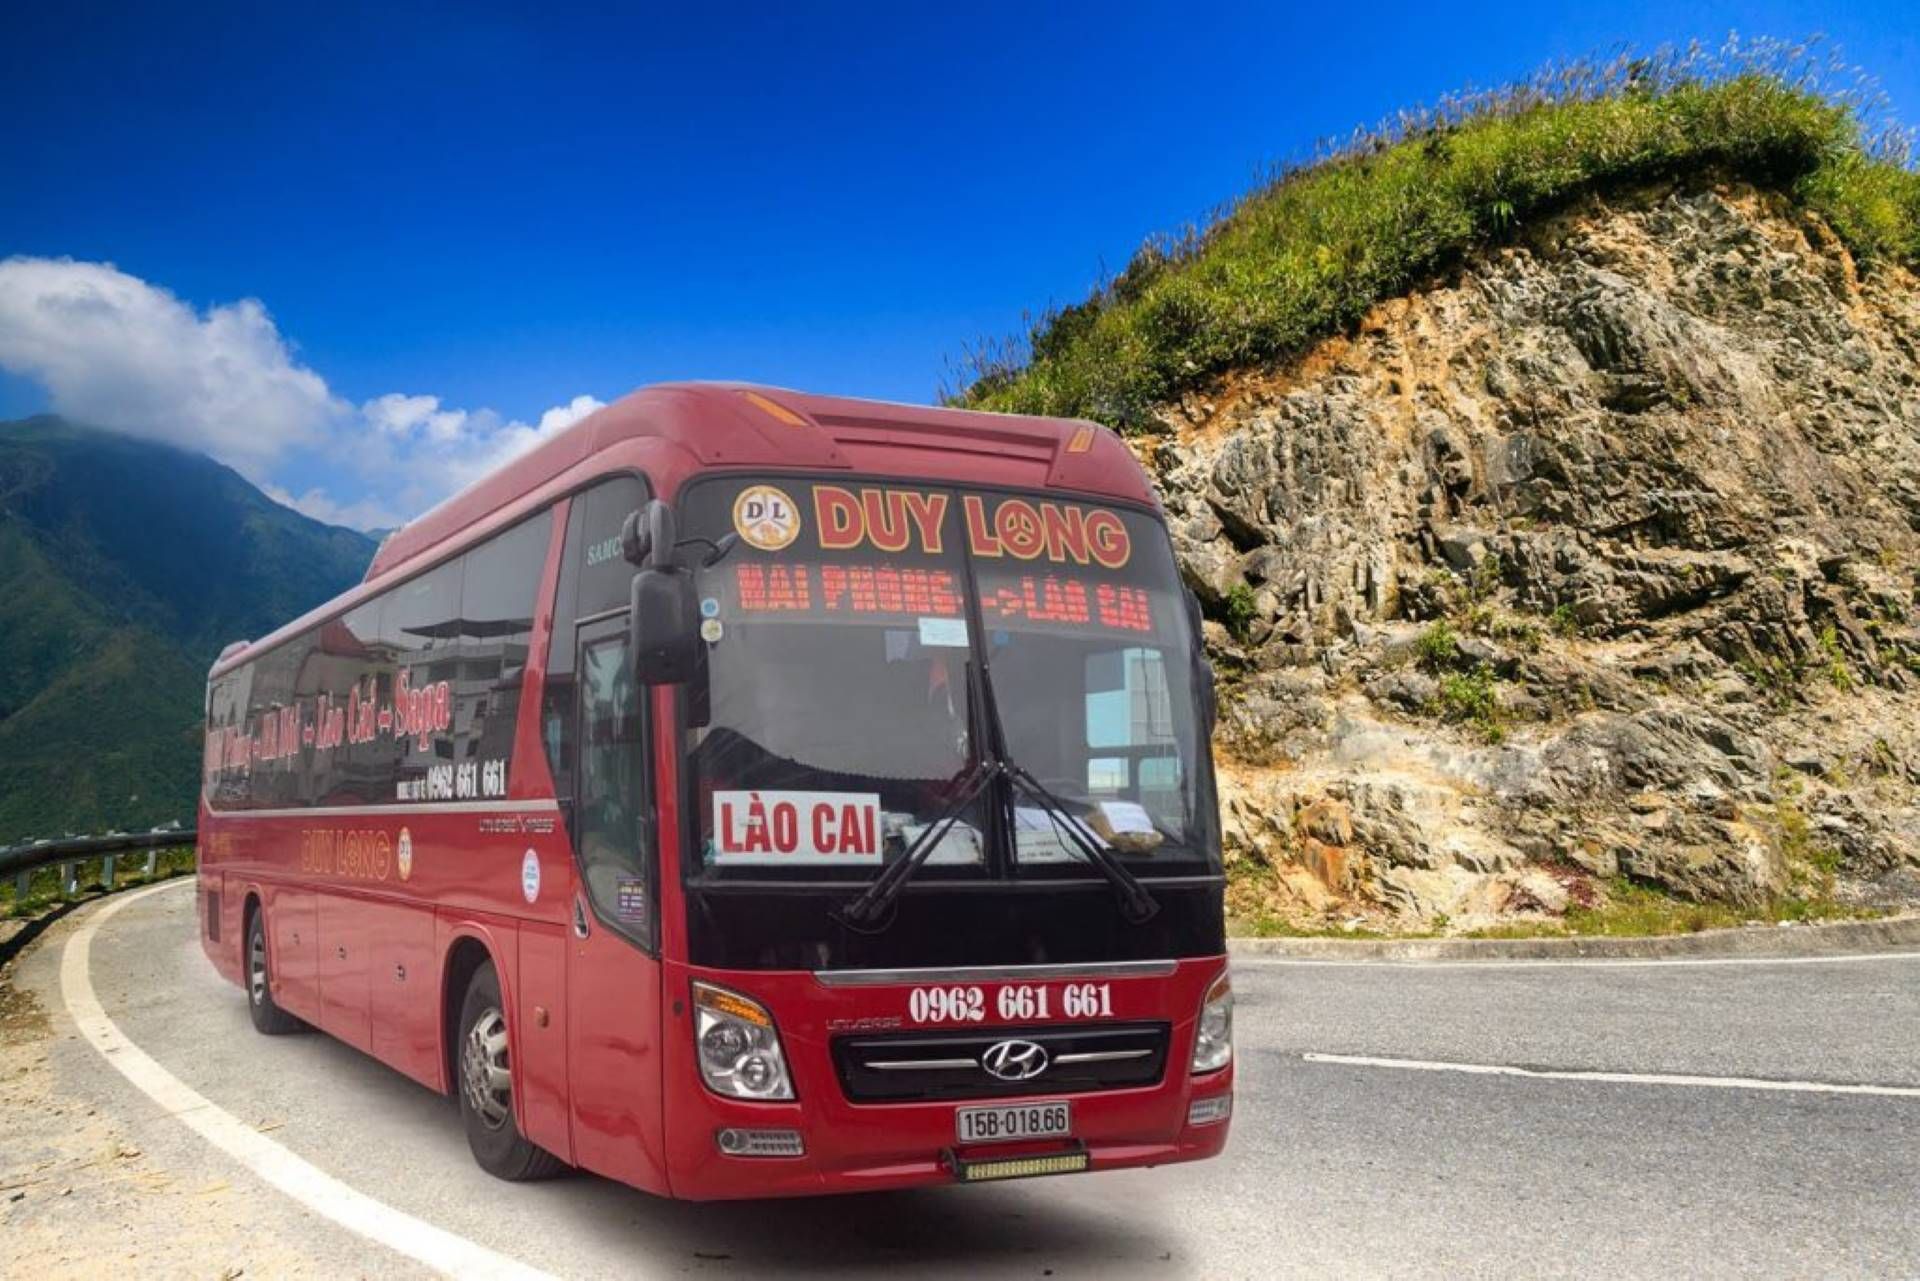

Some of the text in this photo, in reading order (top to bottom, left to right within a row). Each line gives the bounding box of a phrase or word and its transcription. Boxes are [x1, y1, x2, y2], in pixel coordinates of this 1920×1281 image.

[812, 486, 1131, 569] DUY LONG
[587, 536, 624, 567] SAMC
[394, 664, 450, 753] Sapa
[456, 762, 478, 799] 661
[482, 759, 506, 797] 661
[721, 791, 876, 854] LÀO CAI
[336, 829, 391, 881] LONG
[908, 983, 1114, 1022] 0962 661 661
[964, 1107, 1066, 1137] 15B-018.66
